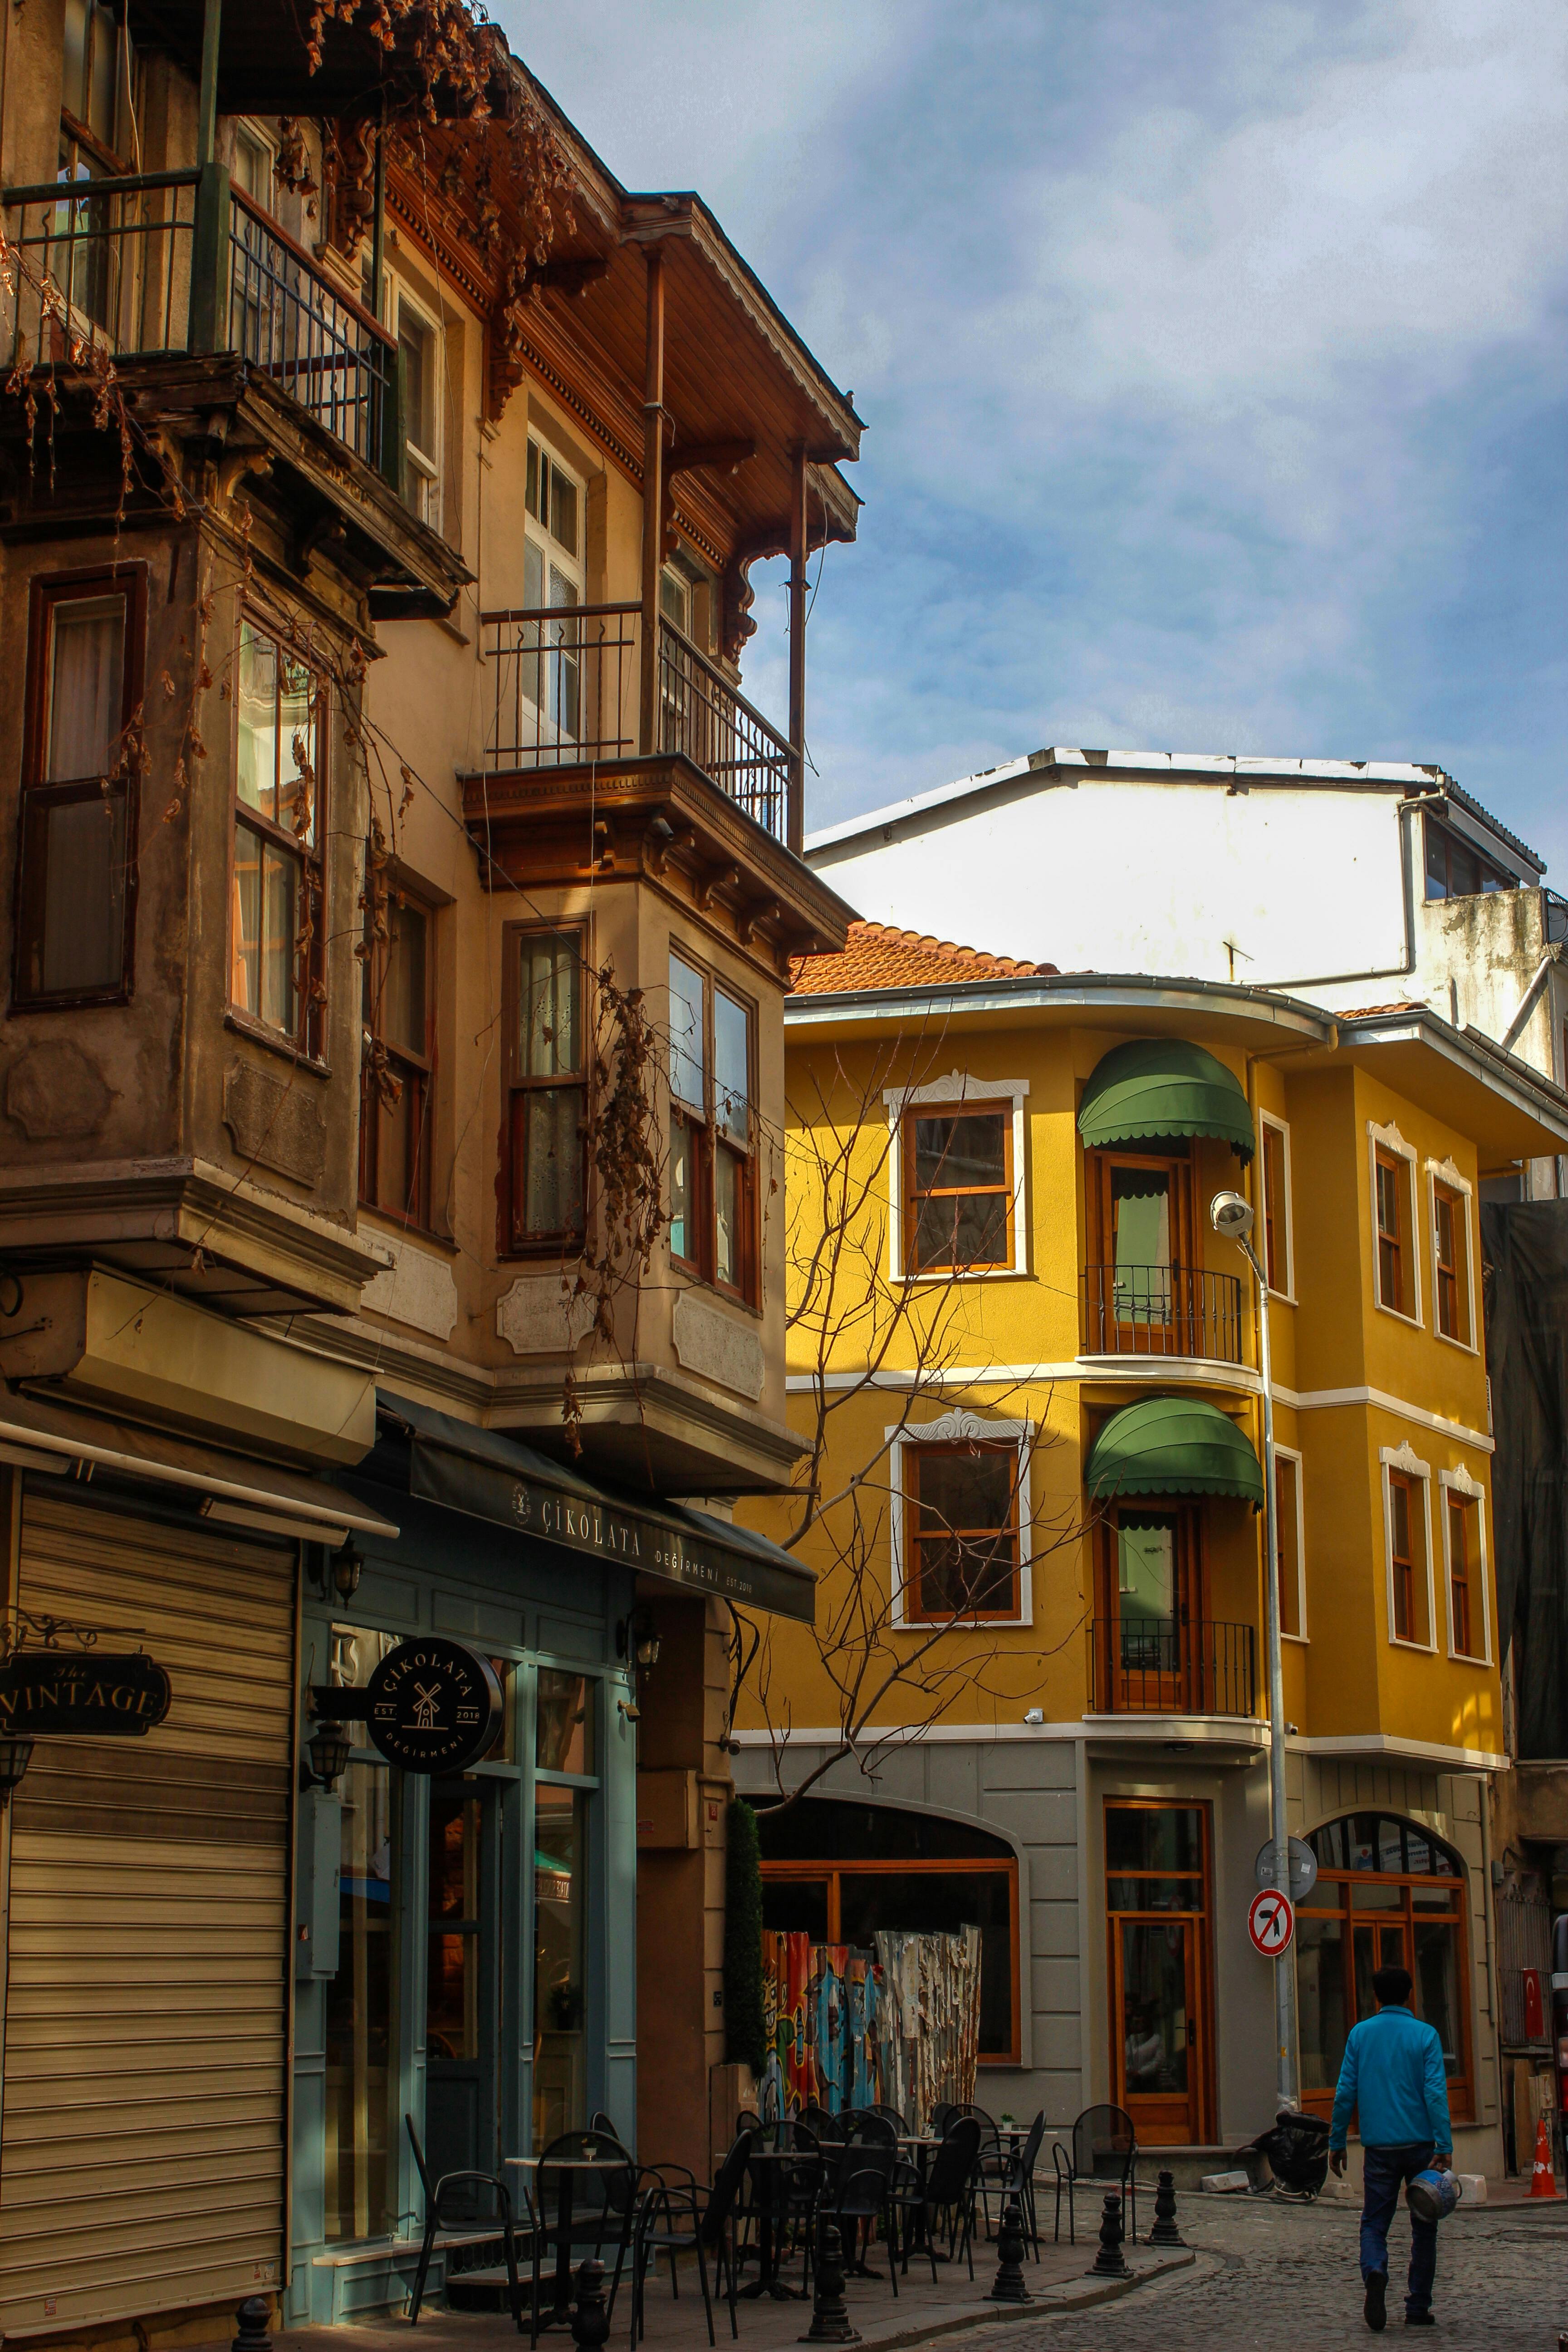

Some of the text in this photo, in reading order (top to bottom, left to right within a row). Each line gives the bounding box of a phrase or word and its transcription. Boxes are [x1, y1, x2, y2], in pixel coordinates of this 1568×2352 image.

[543, 1499, 640, 1556] ÇİKOLATA
[656, 1550, 718, 1582] DEĞİRMENİ
[383, 1653, 472, 1696] ÇİKOLATA
[0, 1681, 157, 1717] VINTAGE
[457, 1711, 480, 1720] 2018
